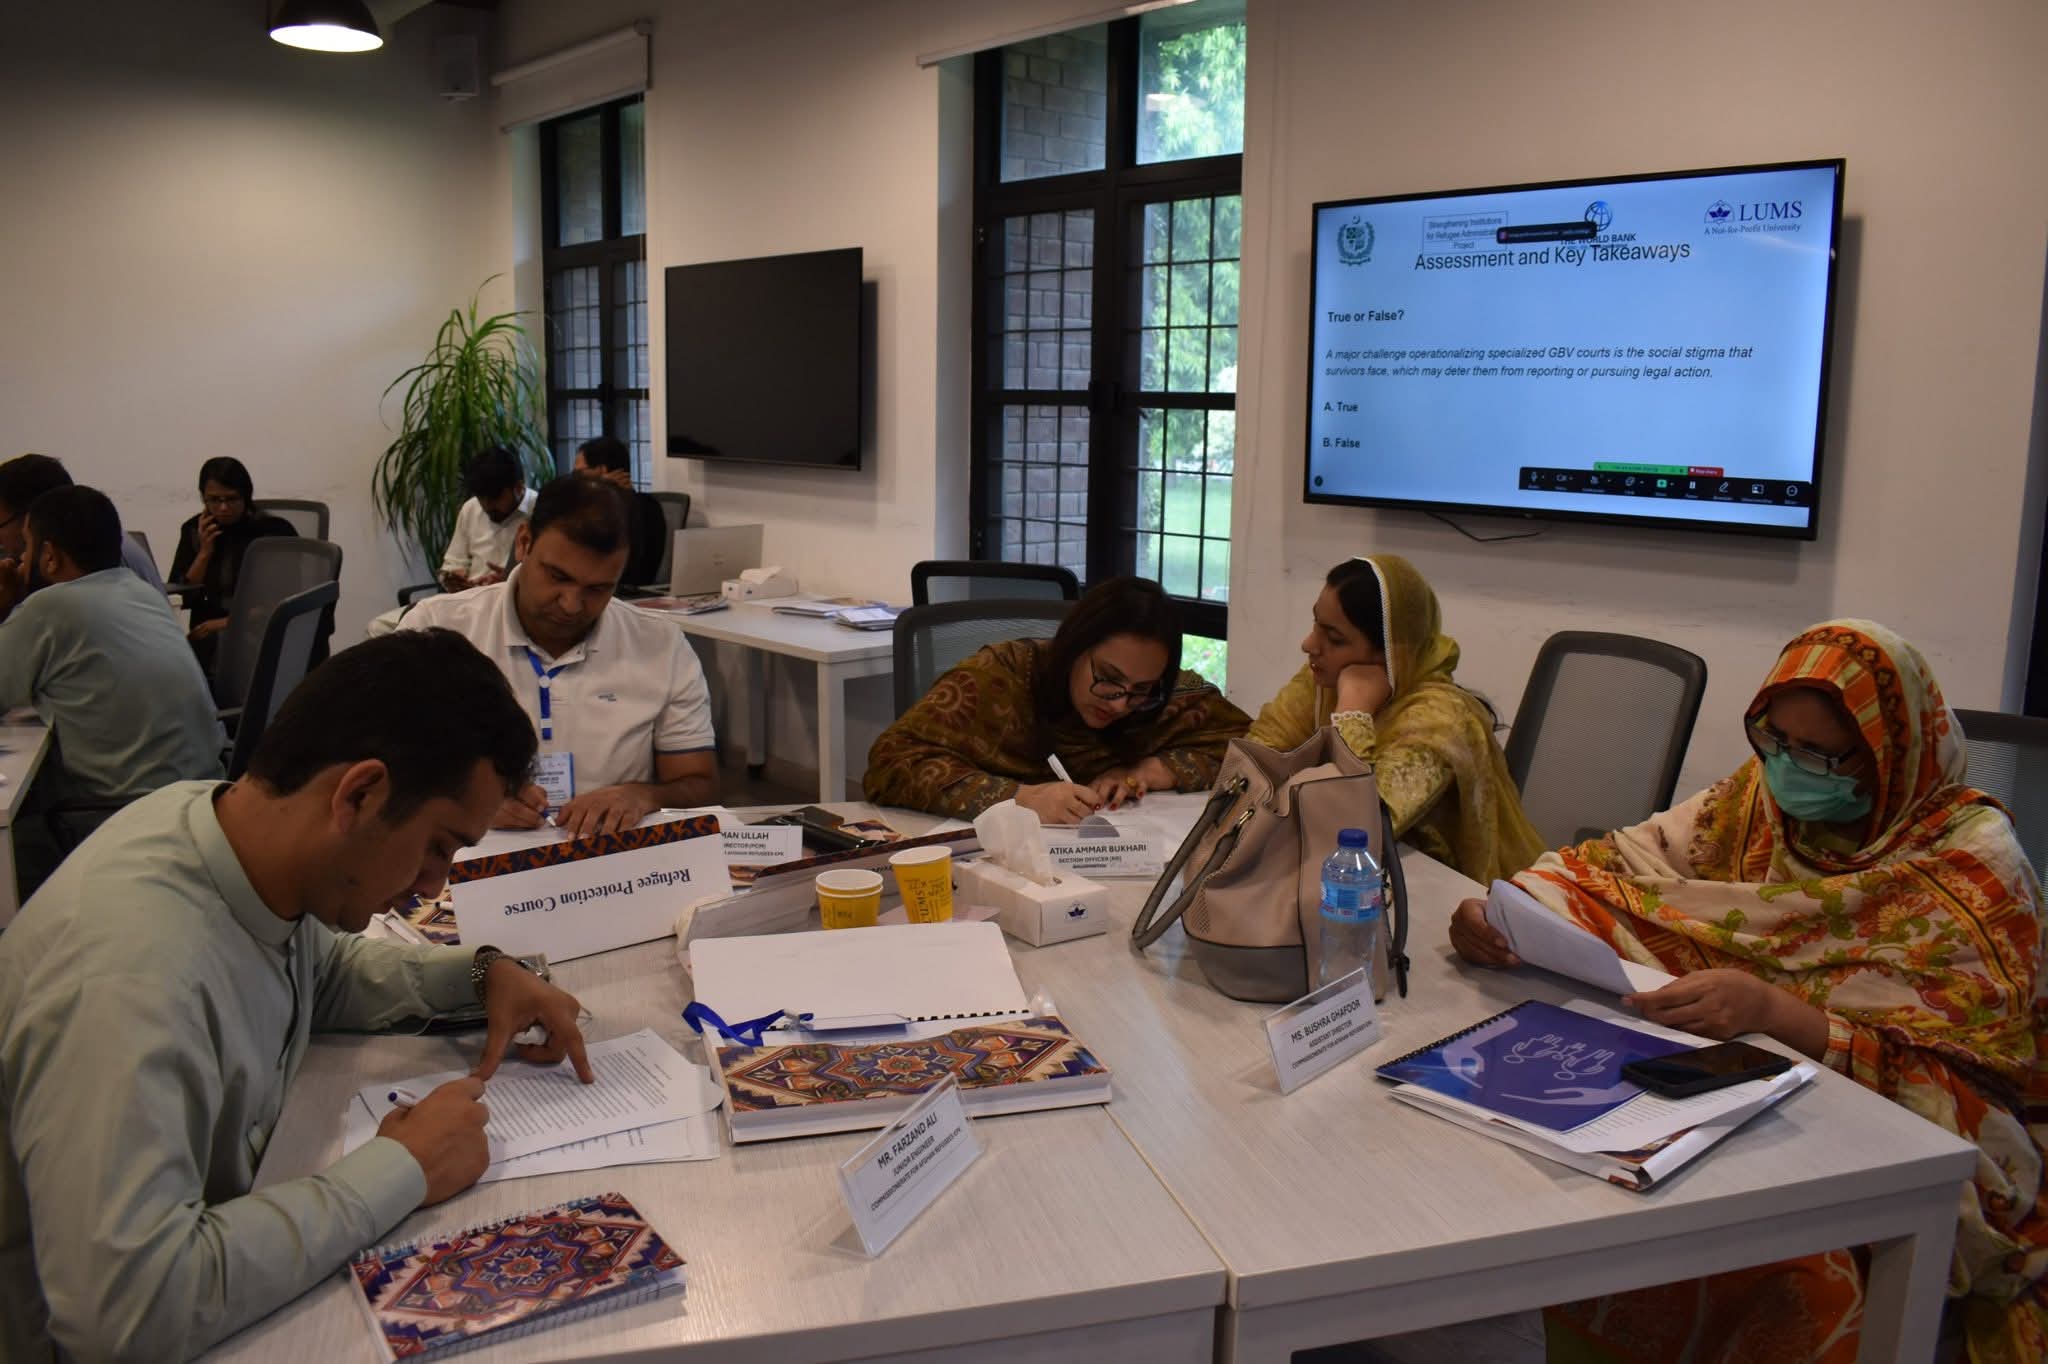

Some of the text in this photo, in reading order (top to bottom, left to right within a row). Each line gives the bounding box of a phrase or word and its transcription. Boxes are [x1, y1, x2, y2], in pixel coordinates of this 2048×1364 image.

[1740, 199, 1803, 222] LUMS
[1763, 223, 1802, 233] University
[1611, 232, 1637, 242] BANK
[1415, 242, 1691, 271] Assessment and Key Takeaways
[1328, 310, 1404, 322] True or False?
[1326, 346, 1753, 361] A major challenge operationalizing specialized GBV courts is the social stigma that
[1325, 366, 1365, 376] survivors
[1392, 366, 1419, 376] which
[1421, 367, 1441, 379] may
[1444, 366, 1471, 376] deter
[1473, 366, 1498, 376] them
[1500, 366, 1524, 376] from
[1526, 365, 1574, 379] reporting
[1576, 367, 1589, 377] or
[1590, 366, 1640, 379] pursuing
[1643, 365, 1671, 379] legal
[1674, 365, 1713, 378] action.
[1324, 401, 1358, 412] A. True
[1322, 437, 1360, 448] B. False
[741, 832, 769, 840] ULLAH
[1049, 844, 1147, 855] ATIKA AMMAR BUKHARI
[504, 868, 692, 917] Refugee Protection Course
[1304, 1015, 1331, 1037] BUSHRA
[1330, 999, 1361, 1021] GHAFOOR
[891, 1121, 926, 1160] FARZAND
[925, 1112, 938, 1129] ALI
